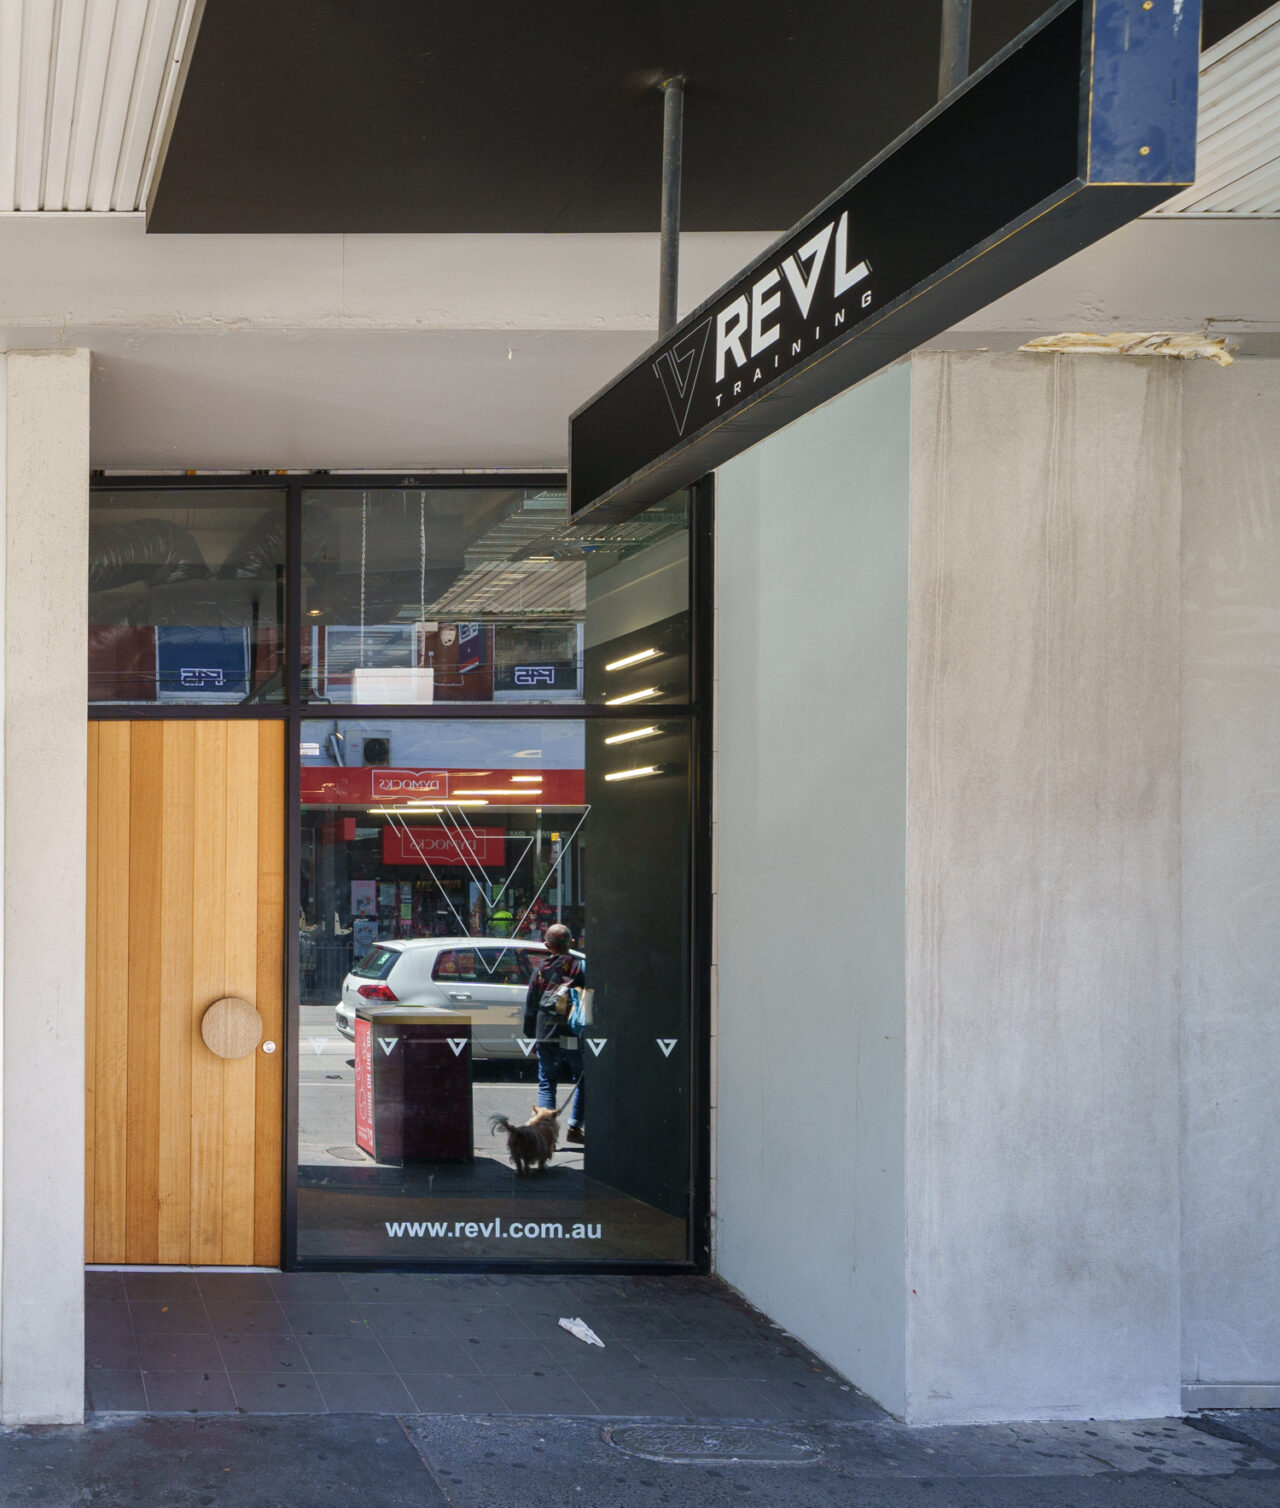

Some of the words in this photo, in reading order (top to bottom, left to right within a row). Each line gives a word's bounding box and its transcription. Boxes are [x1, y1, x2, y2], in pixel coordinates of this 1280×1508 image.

[714, 210, 872, 383] REVL
[714, 289, 872, 407] TRAINING
[384, 1218, 602, 1240] www.revl.com.au
